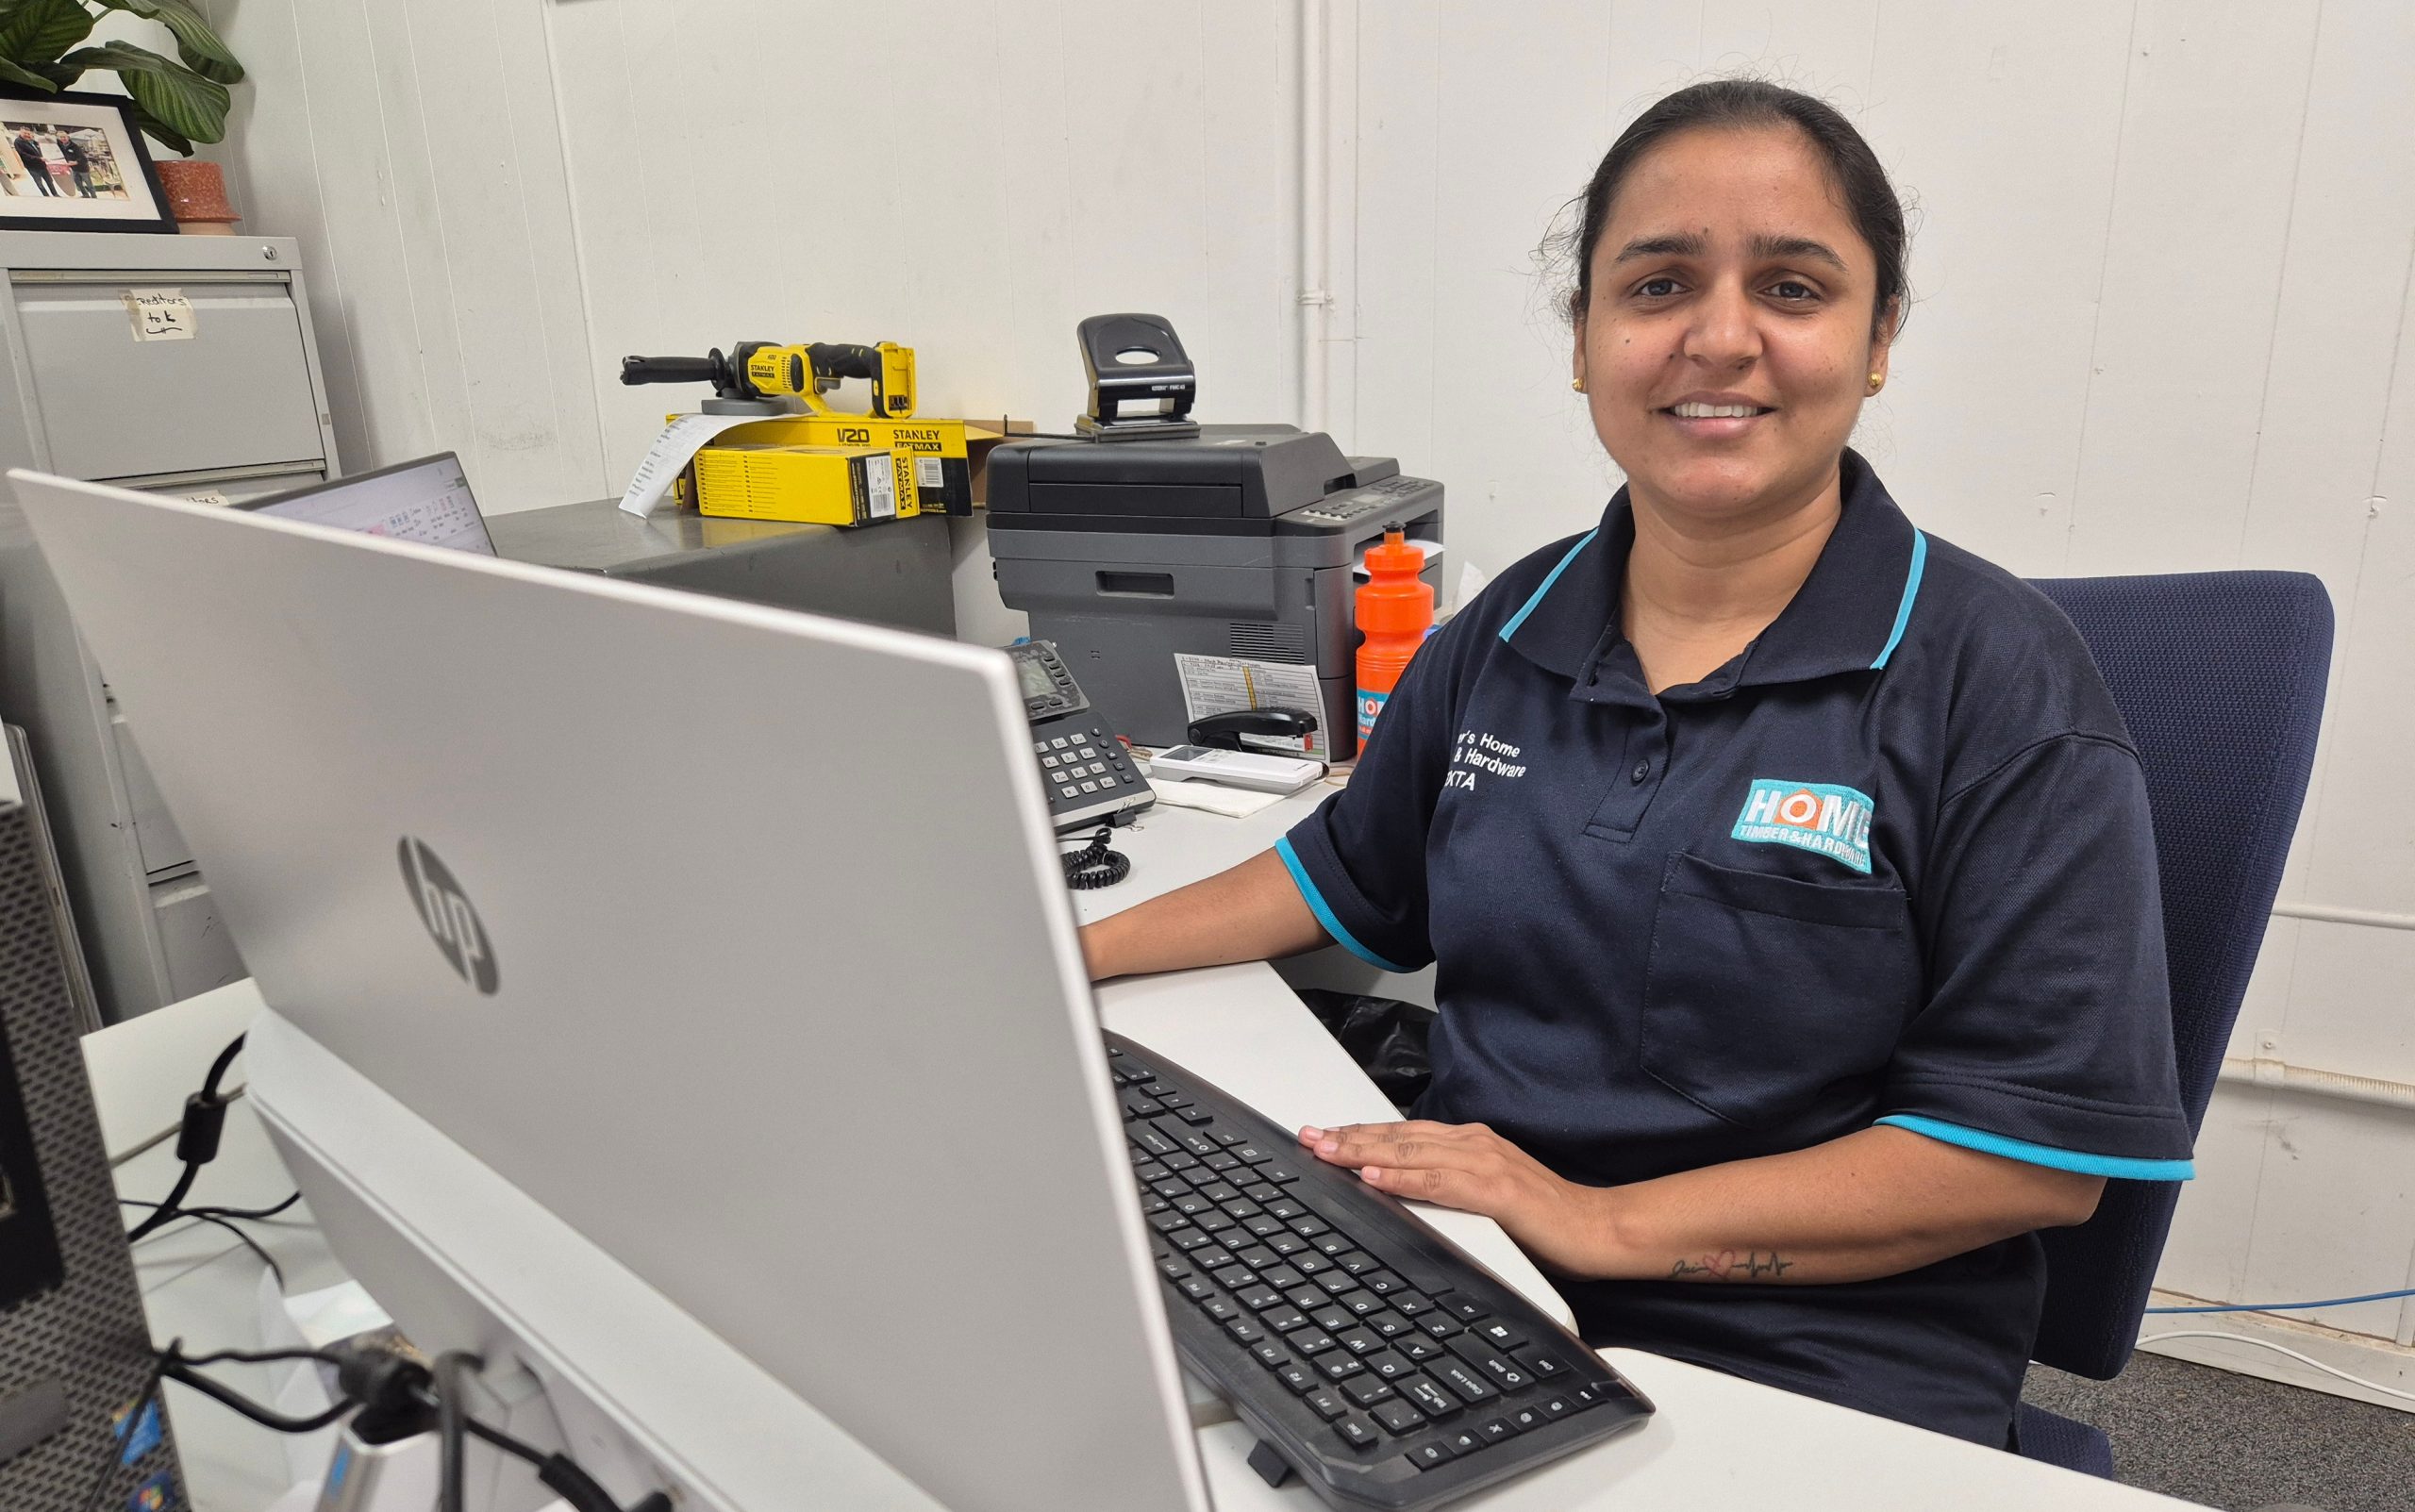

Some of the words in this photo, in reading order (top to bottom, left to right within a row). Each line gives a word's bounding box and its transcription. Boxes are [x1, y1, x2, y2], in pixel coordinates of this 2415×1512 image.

[147, 312, 161, 323] to
[750, 364, 774, 373] STANLEY
[892, 429, 941, 440] STANLEY
[895, 458, 906, 510] FATMAX
[902, 457, 913, 509] STANLEY
[1479, 732, 1521, 758] Home
[1454, 746, 1463, 763] &
[1464, 747, 1527, 778] Hardware
[1745, 789, 1873, 849] HOME
[400, 834, 493, 993] hp
[1300, 1297, 1313, 1305] R
[1355, 1303, 1368, 1311] D
[1403, 1303, 1417, 1311] X
[1325, 1319, 1340, 1327] E
[1432, 1324, 1445, 1333] Z
[1349, 1339, 1366, 1350] W
[1411, 1346, 1425, 1354] A
[1382, 1363, 1395, 1373] Q
